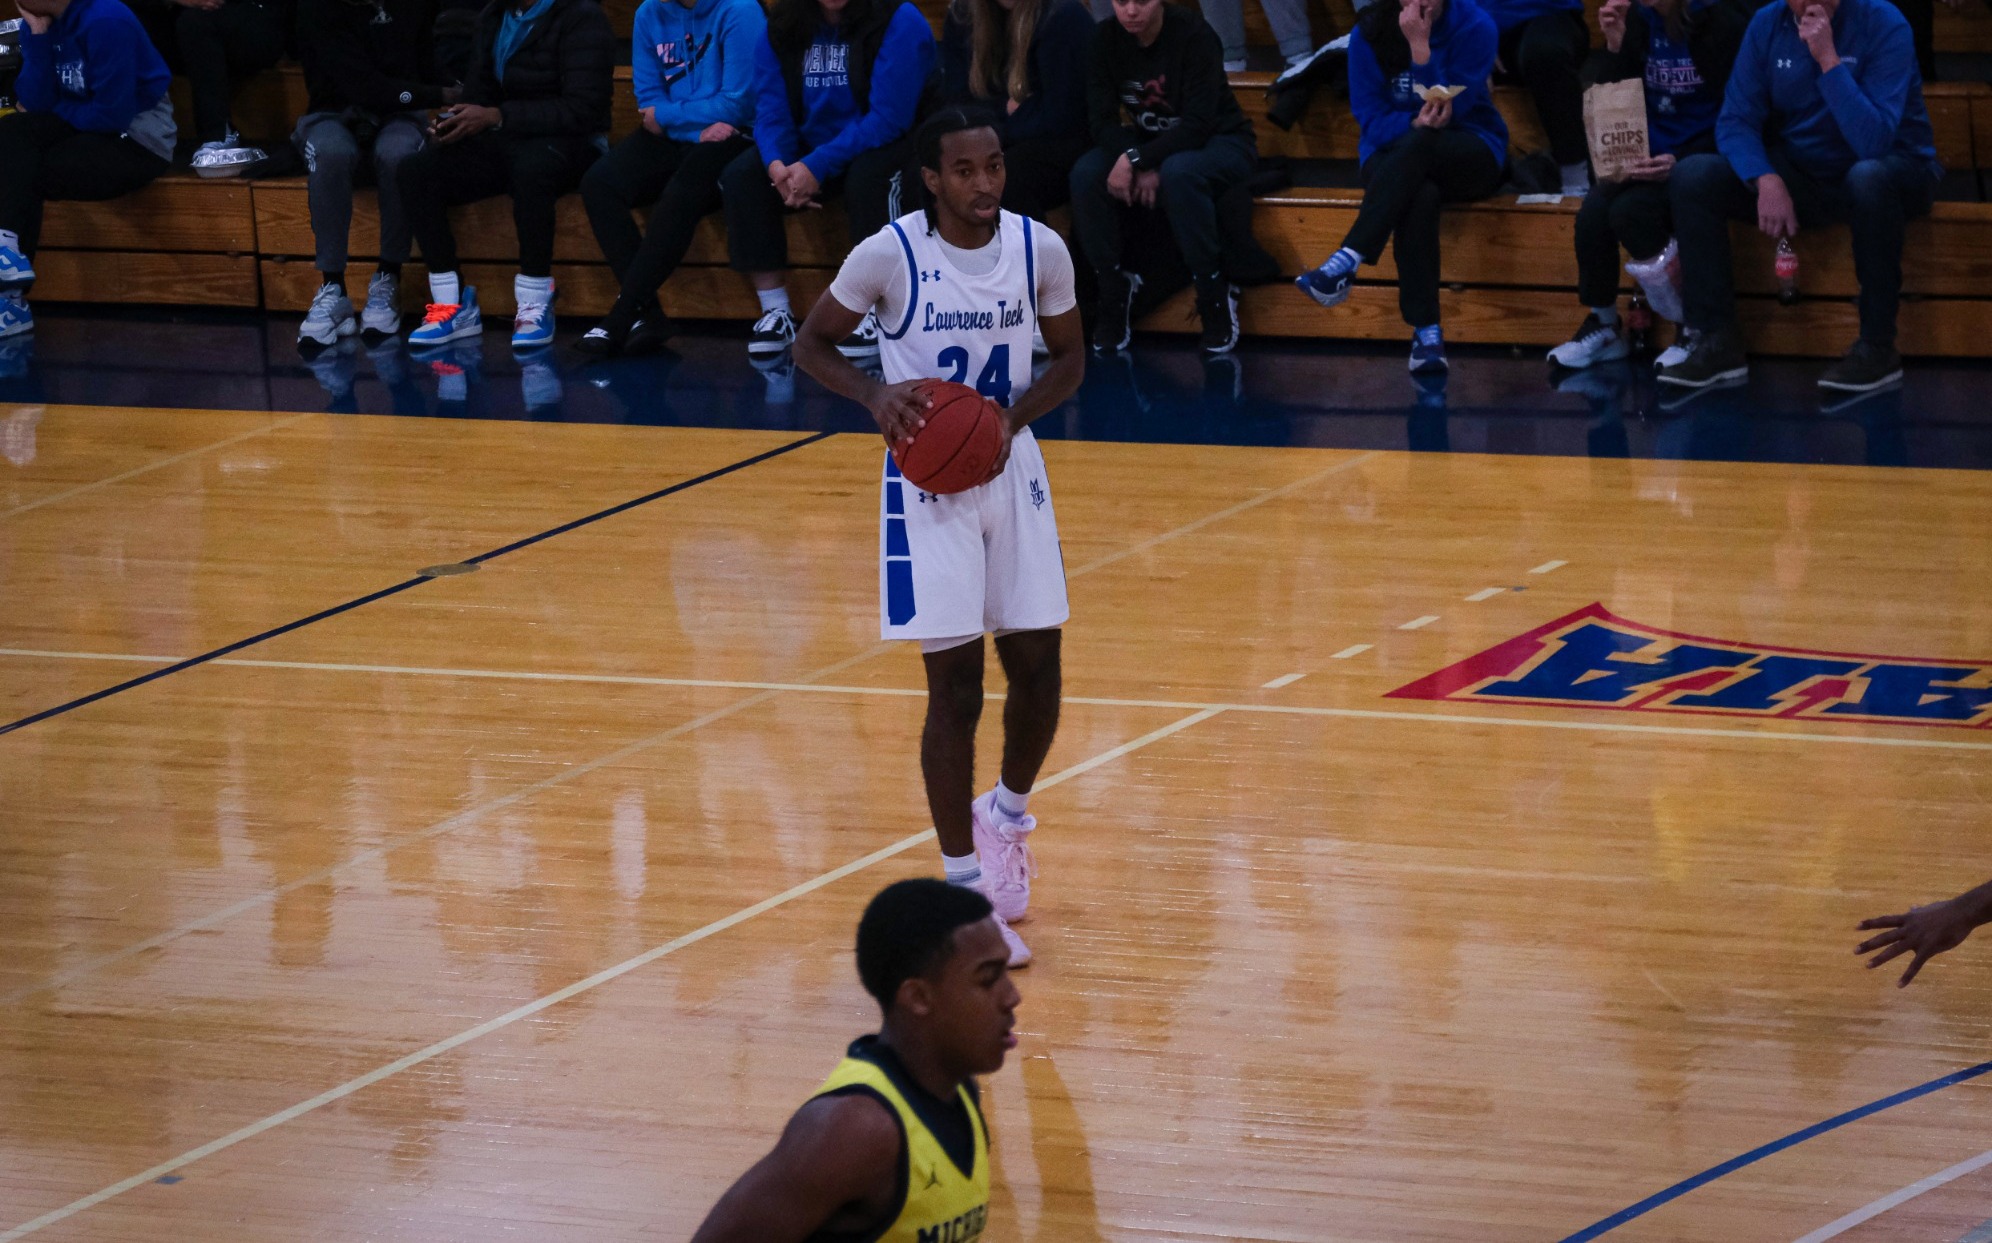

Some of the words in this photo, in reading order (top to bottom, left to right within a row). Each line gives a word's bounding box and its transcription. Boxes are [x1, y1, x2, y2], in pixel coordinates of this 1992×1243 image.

[1600, 130, 1644, 146] CHIPS
[922, 301, 995, 333] Lawrence
[997, 298, 1024, 330] Tech
[937, 343, 1012, 409] 24
